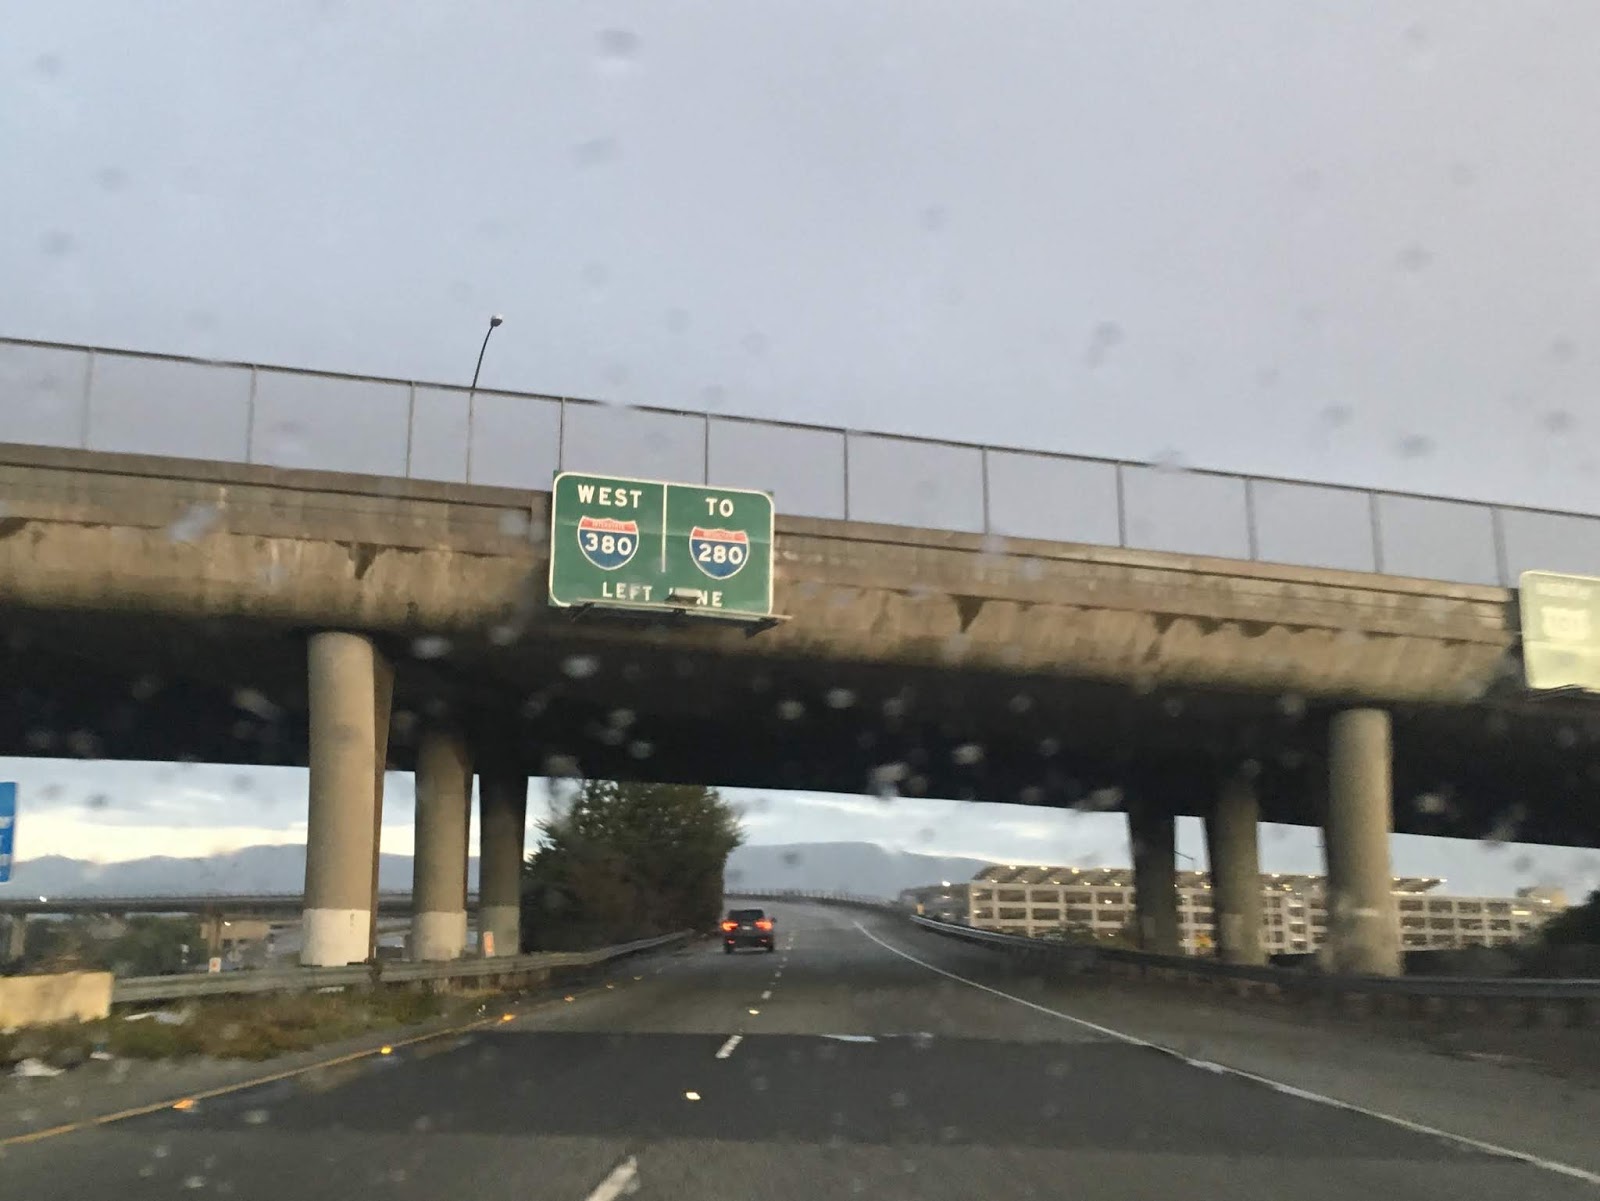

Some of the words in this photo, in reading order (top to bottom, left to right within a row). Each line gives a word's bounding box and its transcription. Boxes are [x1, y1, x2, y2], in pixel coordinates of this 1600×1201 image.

[577, 484, 642, 508] WEST
[705, 496, 734, 518] TO
[584, 532, 632, 556] 380
[698, 543, 743, 565] 280
[602, 581, 653, 602] LEFT
[668, 587, 723, 608] NE
